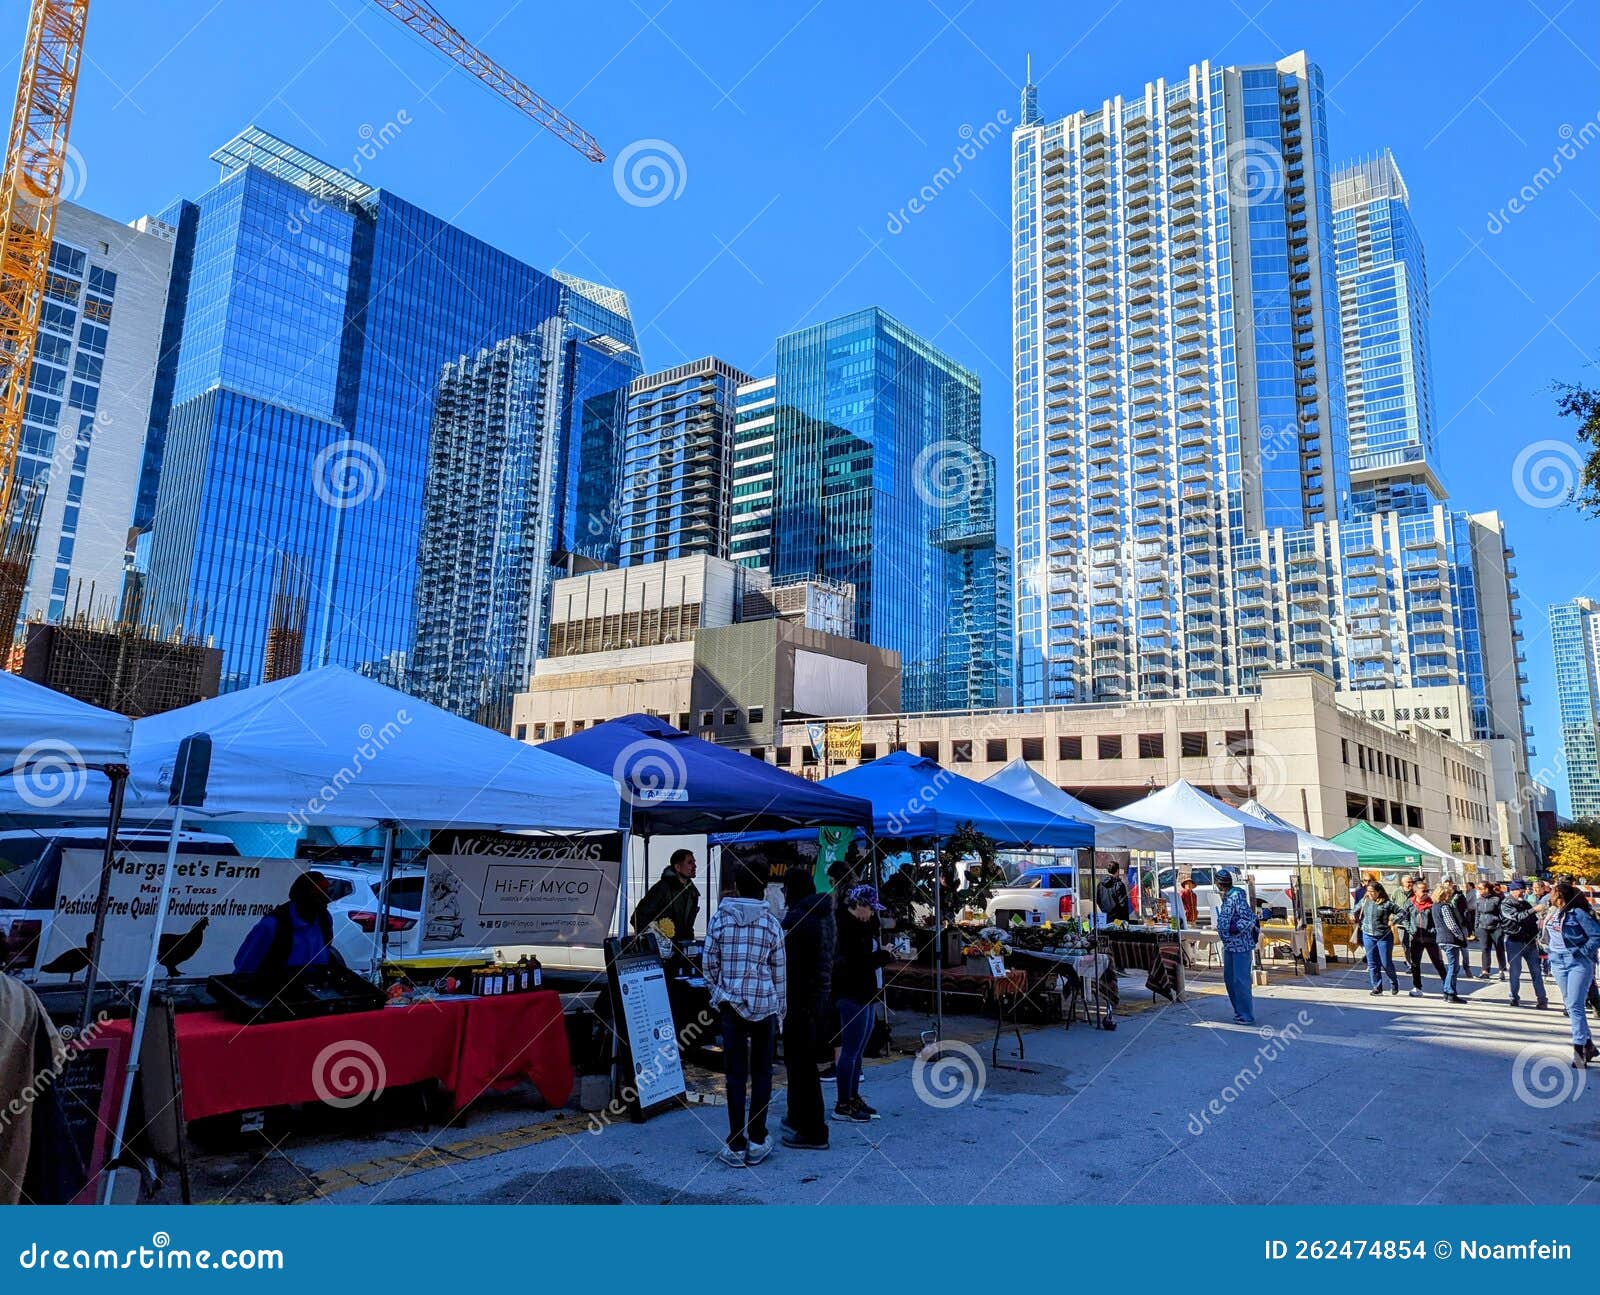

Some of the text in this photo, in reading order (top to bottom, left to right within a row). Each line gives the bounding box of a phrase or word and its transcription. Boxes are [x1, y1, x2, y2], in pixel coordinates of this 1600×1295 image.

[828, 740, 860, 748] EEKEND
[828, 749, 860, 757] ARKING
[452, 836, 602, 860] MUSHROOMS
[214, 861, 260, 878] Farm
[185, 885, 217, 894] Texas
[495, 880, 589, 894] Hi-Fi MYCO
[58, 894, 102, 915] Pestisid
[105, 896, 128, 914] Free
[131, 896, 161, 920] Quali
[168, 897, 209, 915] Products
[211, 899, 228, 915] and
[229, 899, 247, 915] free
